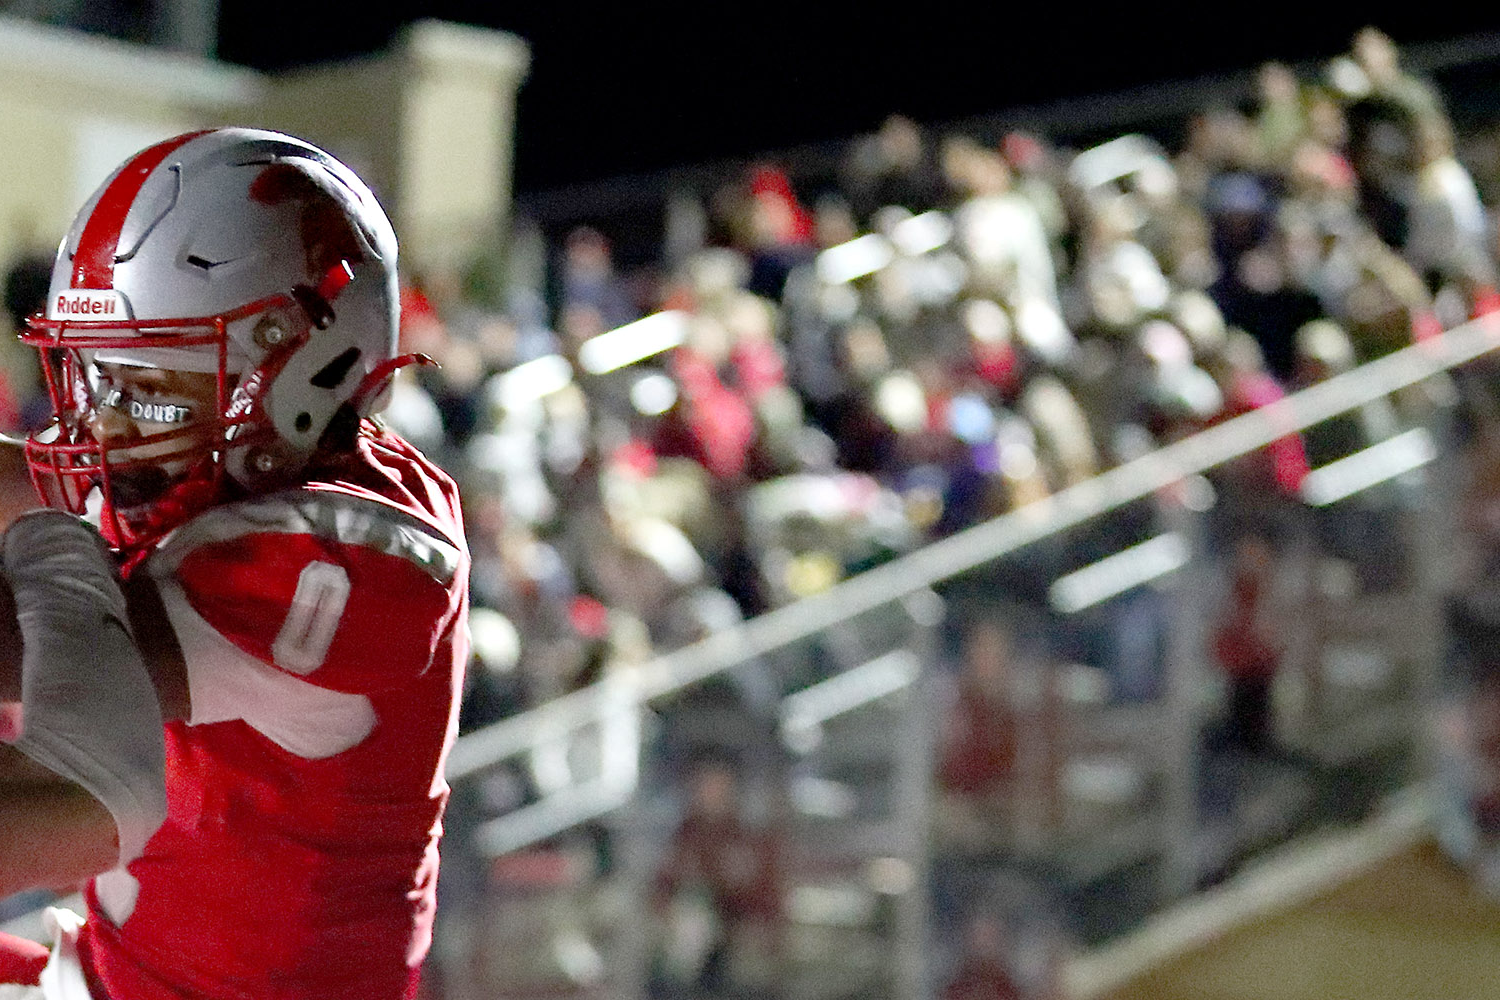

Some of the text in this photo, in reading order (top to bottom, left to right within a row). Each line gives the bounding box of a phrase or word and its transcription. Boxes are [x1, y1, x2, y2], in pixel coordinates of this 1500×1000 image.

[58, 295, 116, 315] Riddell
[131, 400, 190, 423] DOUBT
[272, 559, 352, 677] 0
